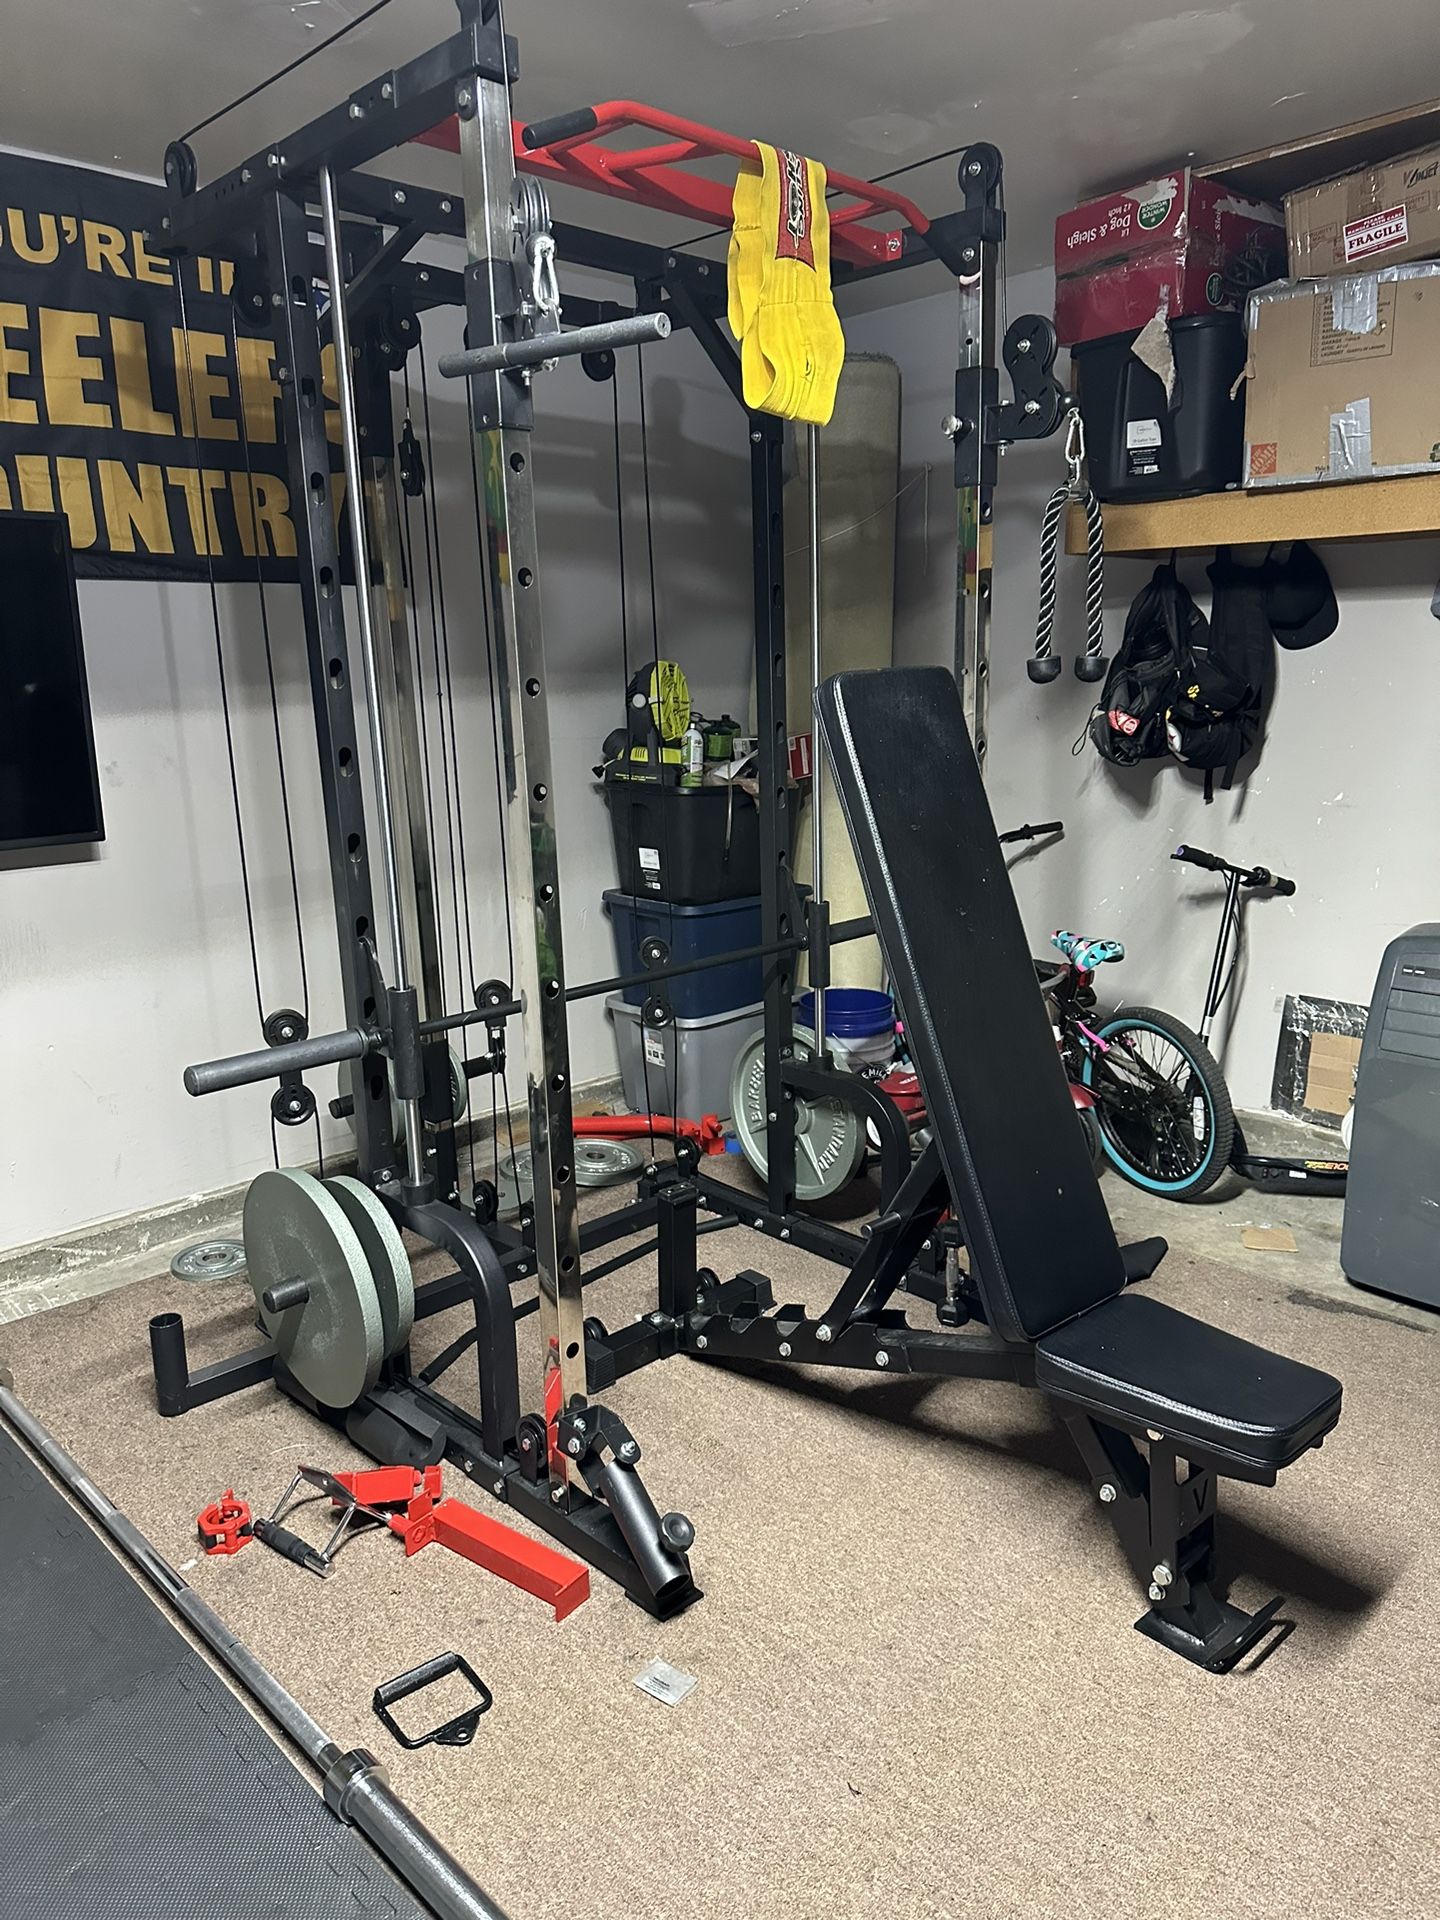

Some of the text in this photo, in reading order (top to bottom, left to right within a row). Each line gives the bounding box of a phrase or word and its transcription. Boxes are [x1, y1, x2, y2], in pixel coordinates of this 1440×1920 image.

[1108, 207, 1122, 217] Inch
[1141, 207, 1166, 220] WINTER
[1363, 215, 1385, 225] PLEASE
[1370, 217, 1386, 228] WITH
[1387, 212, 1403, 221] CARE
[1067, 214, 1131, 249] Dog & Sleigh
[1348, 222, 1404, 249] FRAGILE
[0, 207, 174, 286] U'RE
[817, 1099, 847, 1173] STANDARD
